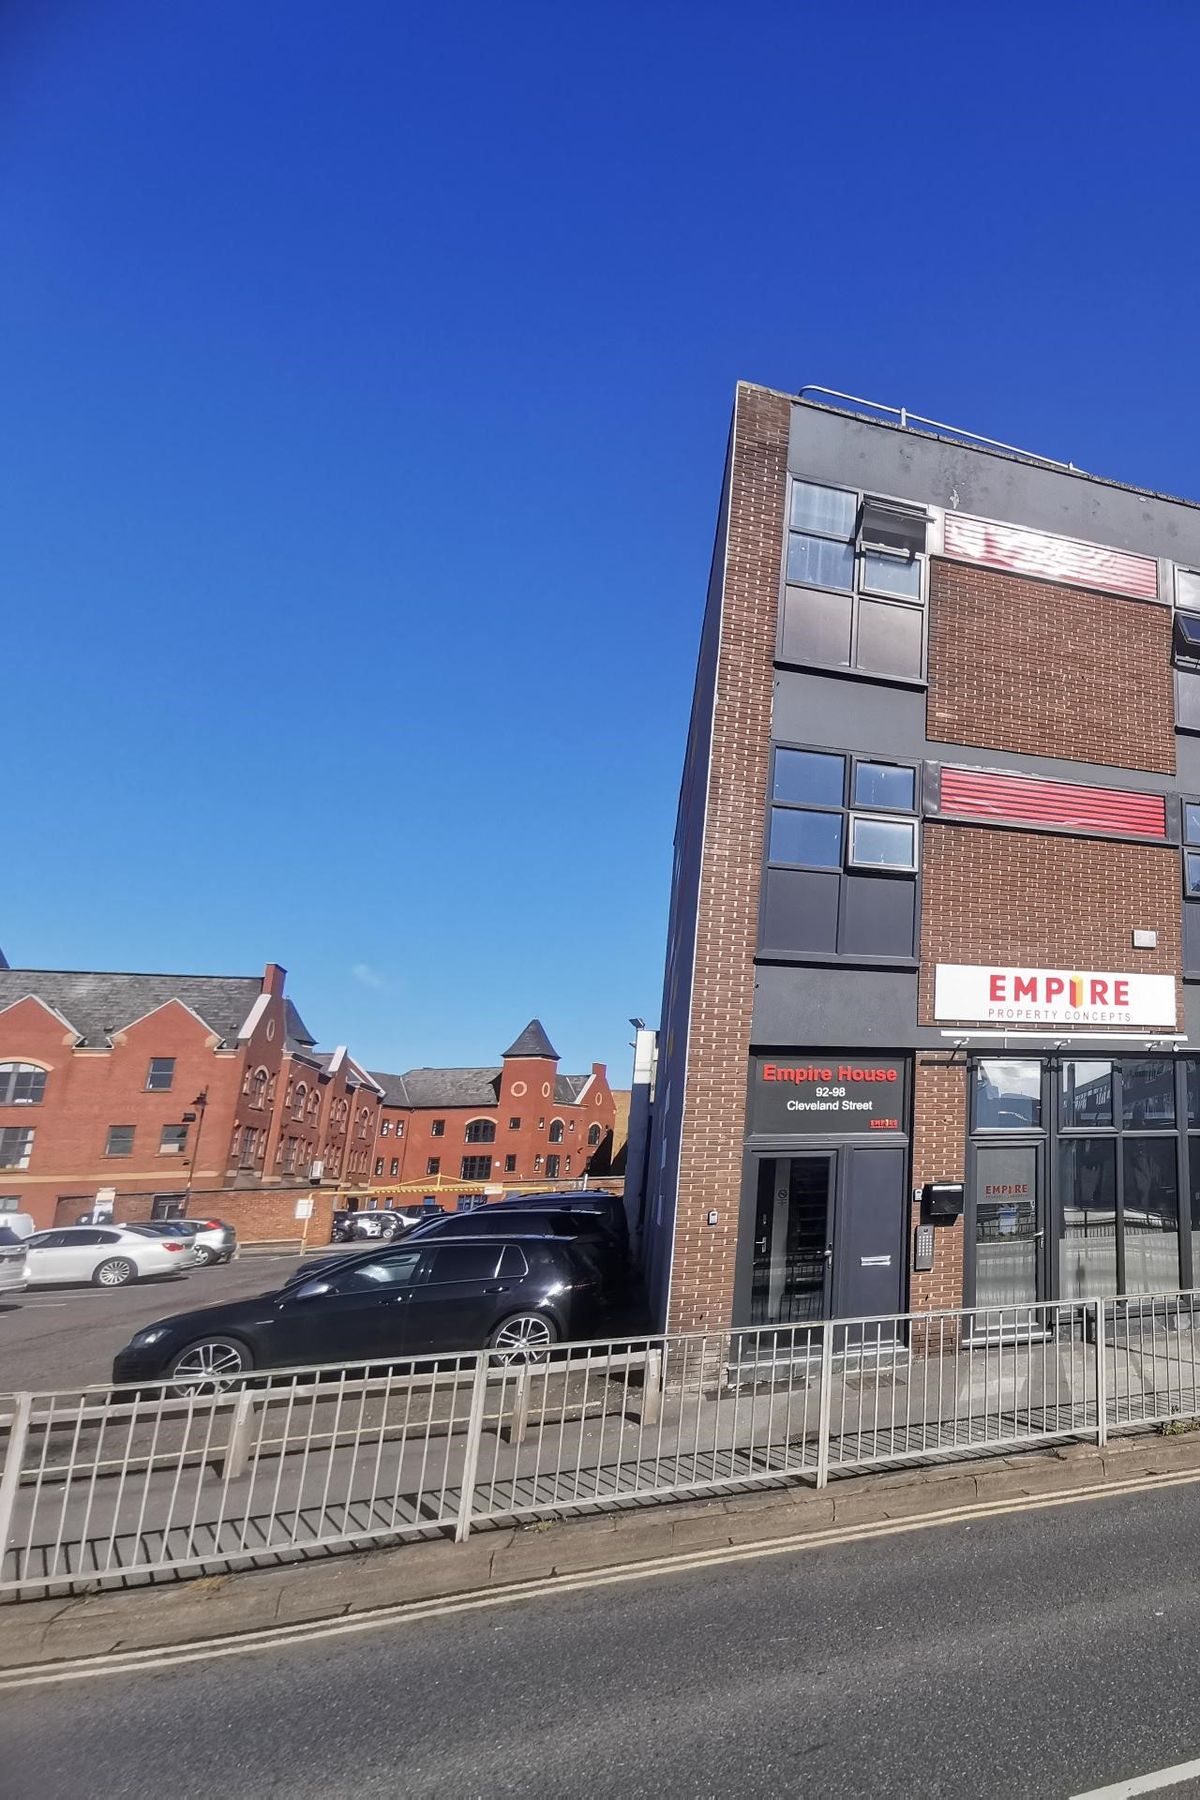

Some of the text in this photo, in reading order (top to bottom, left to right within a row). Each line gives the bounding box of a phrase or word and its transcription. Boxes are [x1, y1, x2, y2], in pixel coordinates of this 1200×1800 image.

[989, 974, 1130, 1009] EMPIRE
[988, 1008, 1131, 1022] PROPERTY CONCEPTS
[762, 1064, 897, 1084] Empire House
[815, 1087, 846, 1097] 92-98
[786, 1100, 873, 1111] Cleveland Street
[985, 1184, 1028, 1195] EMPIRE
